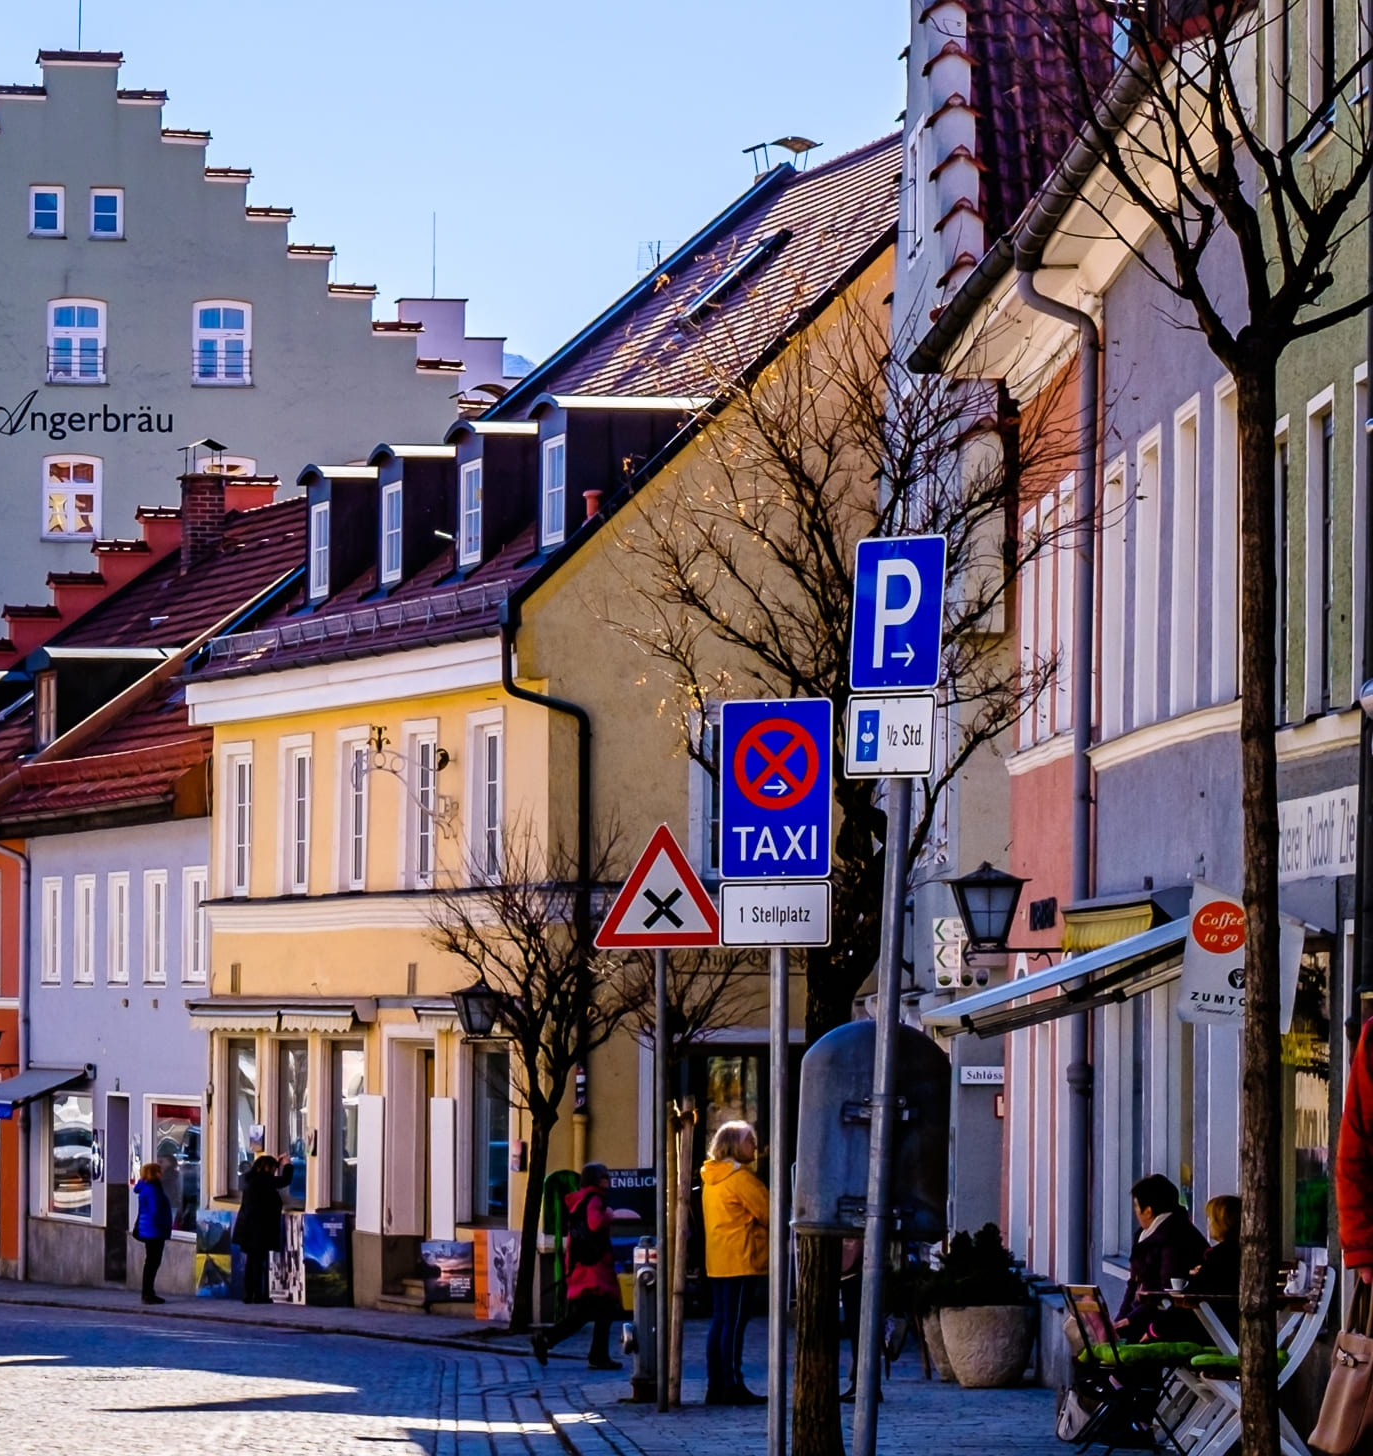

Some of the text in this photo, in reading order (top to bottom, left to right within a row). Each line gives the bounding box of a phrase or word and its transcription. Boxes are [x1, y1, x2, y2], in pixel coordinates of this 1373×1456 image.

[872, 558, 922, 669] P
[902, 723, 925, 747] Std.
[732, 825, 817, 861] TAXI
[1306, 799, 1335, 870] Rudolf
[739, 905, 811, 927] 1 Stellplatz
[1199, 912, 1245, 929] Coffee
[1204, 933, 1239, 947] to go
